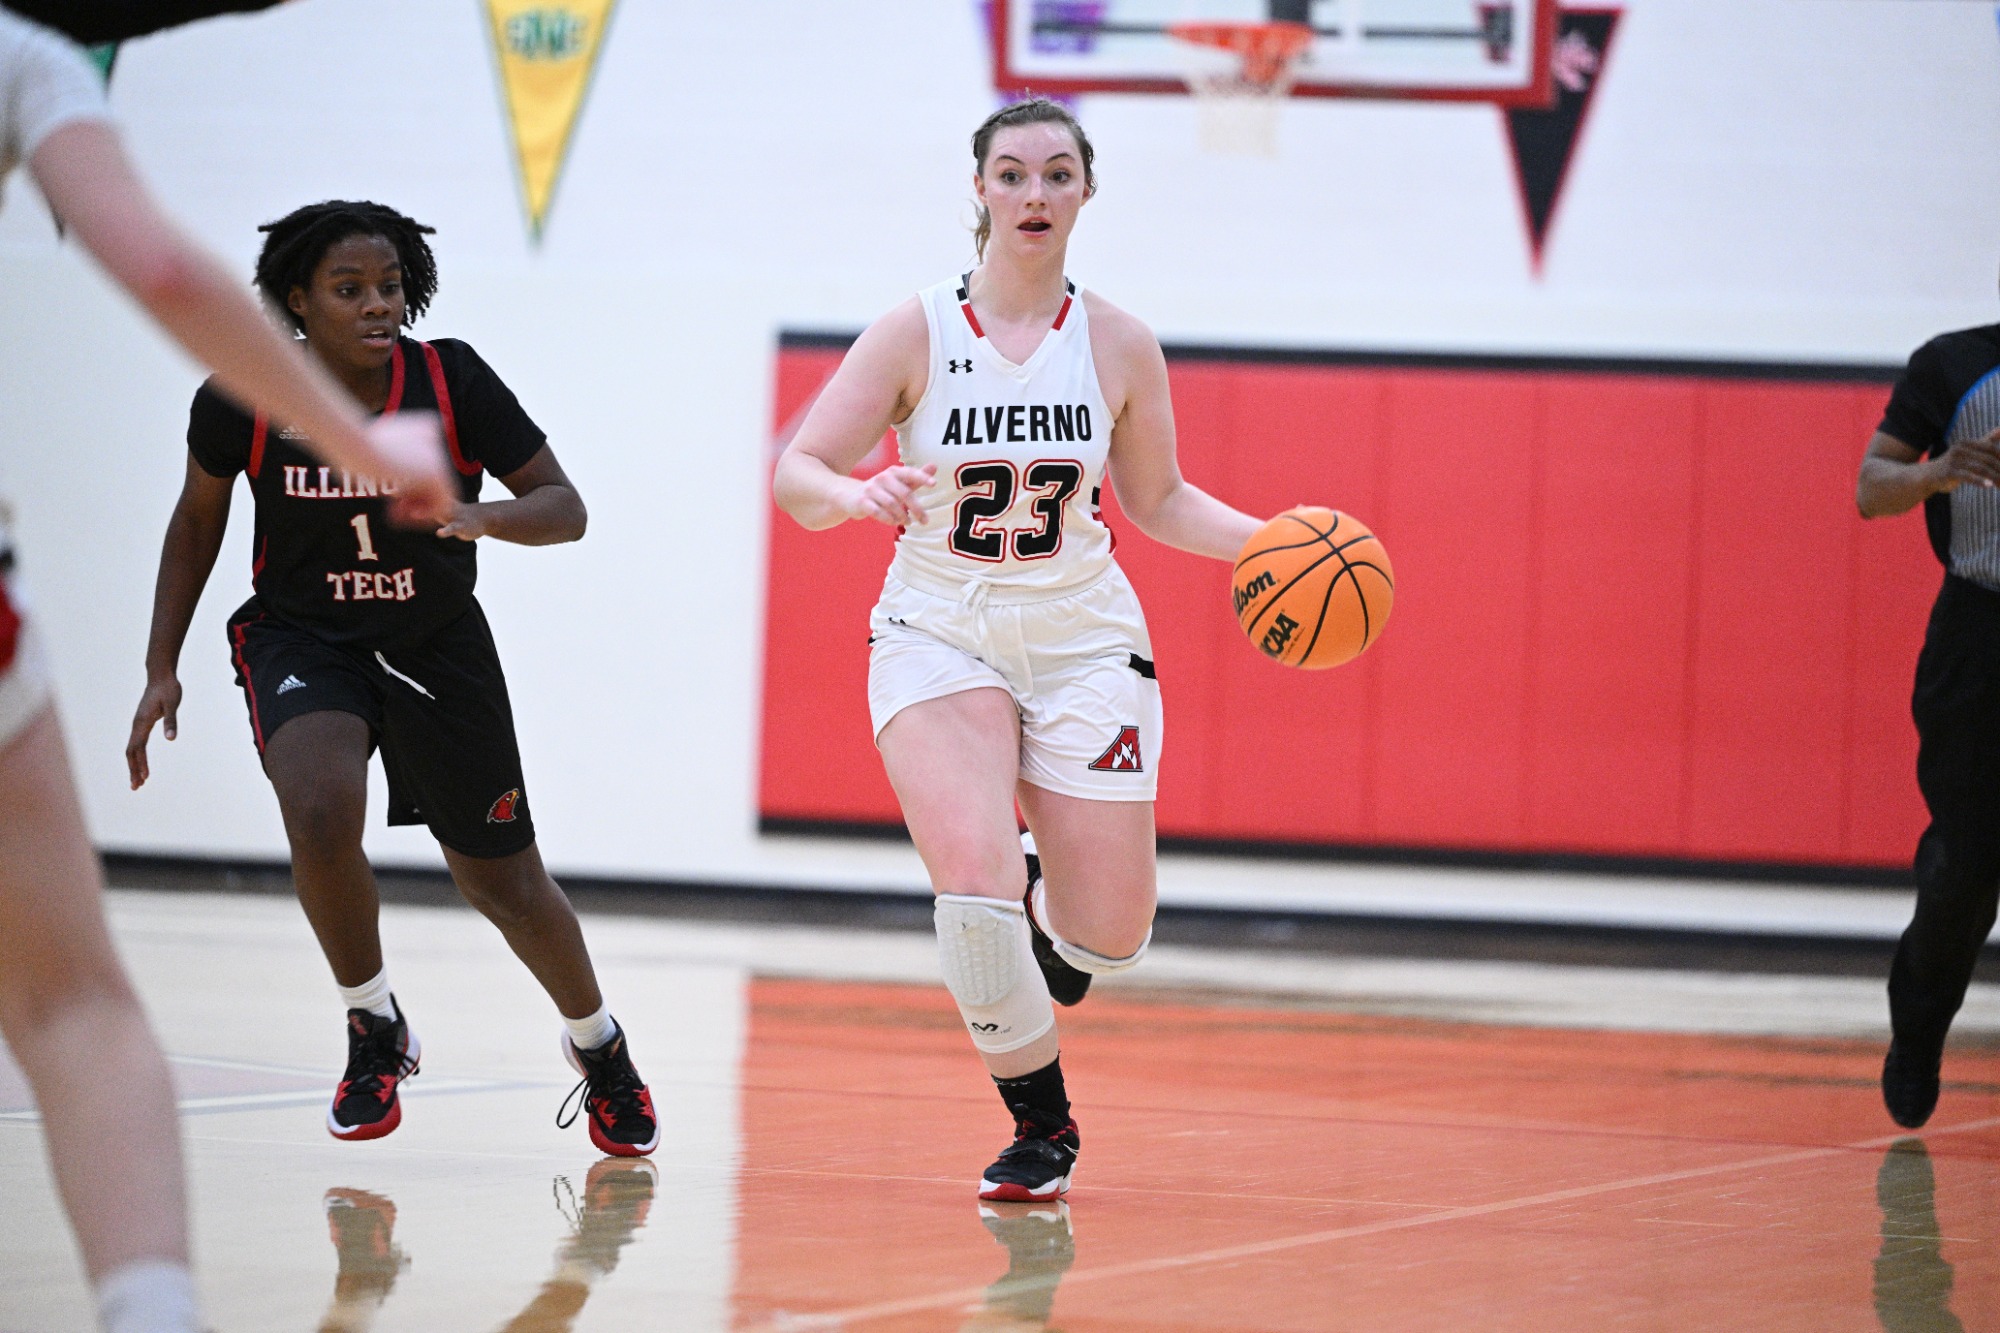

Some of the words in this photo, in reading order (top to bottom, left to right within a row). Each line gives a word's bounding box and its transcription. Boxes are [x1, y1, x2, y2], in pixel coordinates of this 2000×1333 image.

[941, 404, 1092, 445] ALVERNO
[949, 459, 1084, 563] 23
[350, 513, 379, 561] 1
[326, 568, 416, 601] TECH
[1233, 570, 1276, 617] lson
[1260, 612, 1299, 659] CAA
